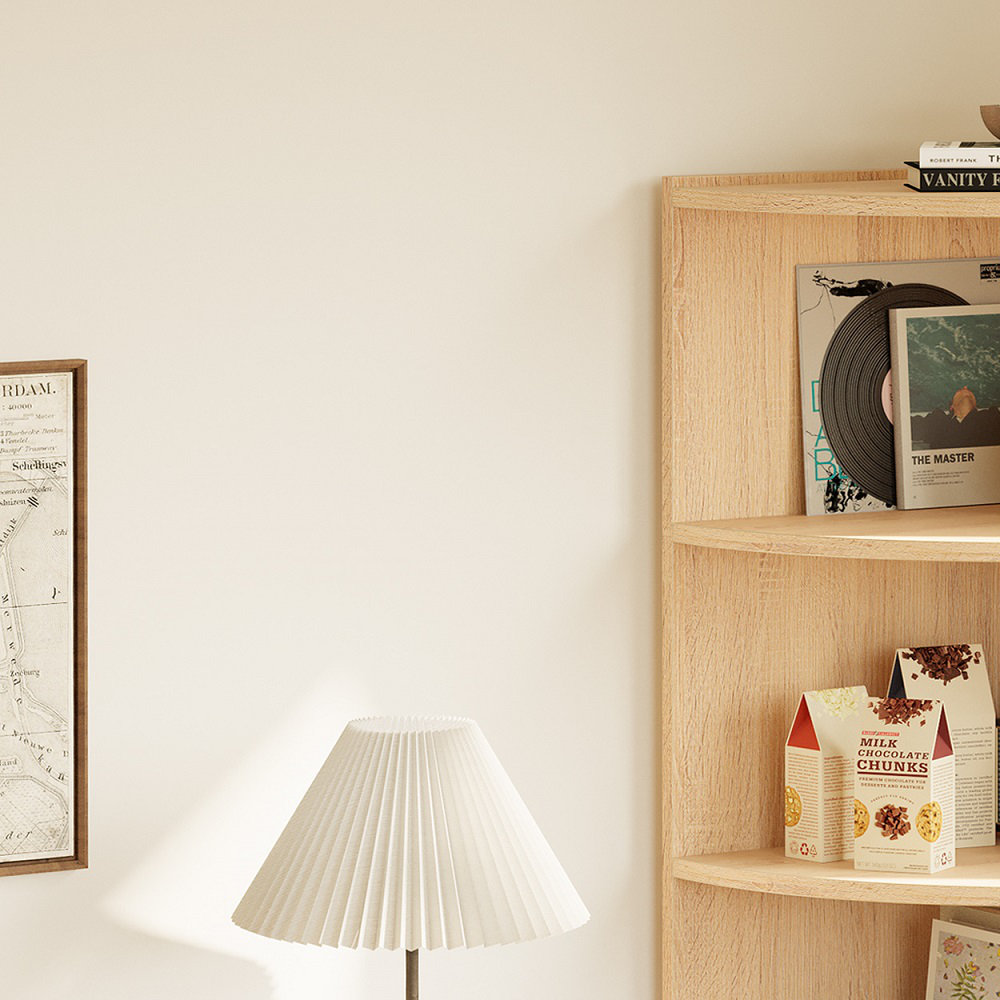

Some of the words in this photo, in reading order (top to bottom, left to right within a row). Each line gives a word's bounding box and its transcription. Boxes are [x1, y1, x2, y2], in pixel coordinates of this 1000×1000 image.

[922, 172, 987, 186] VANITY
[912, 455, 931, 465] THE
[934, 452, 975, 464] MASTER
[860, 738, 898, 748] MILK
[858, 749, 930, 760] CHOCOLATE
[856, 759, 928, 773] CHUNKS
